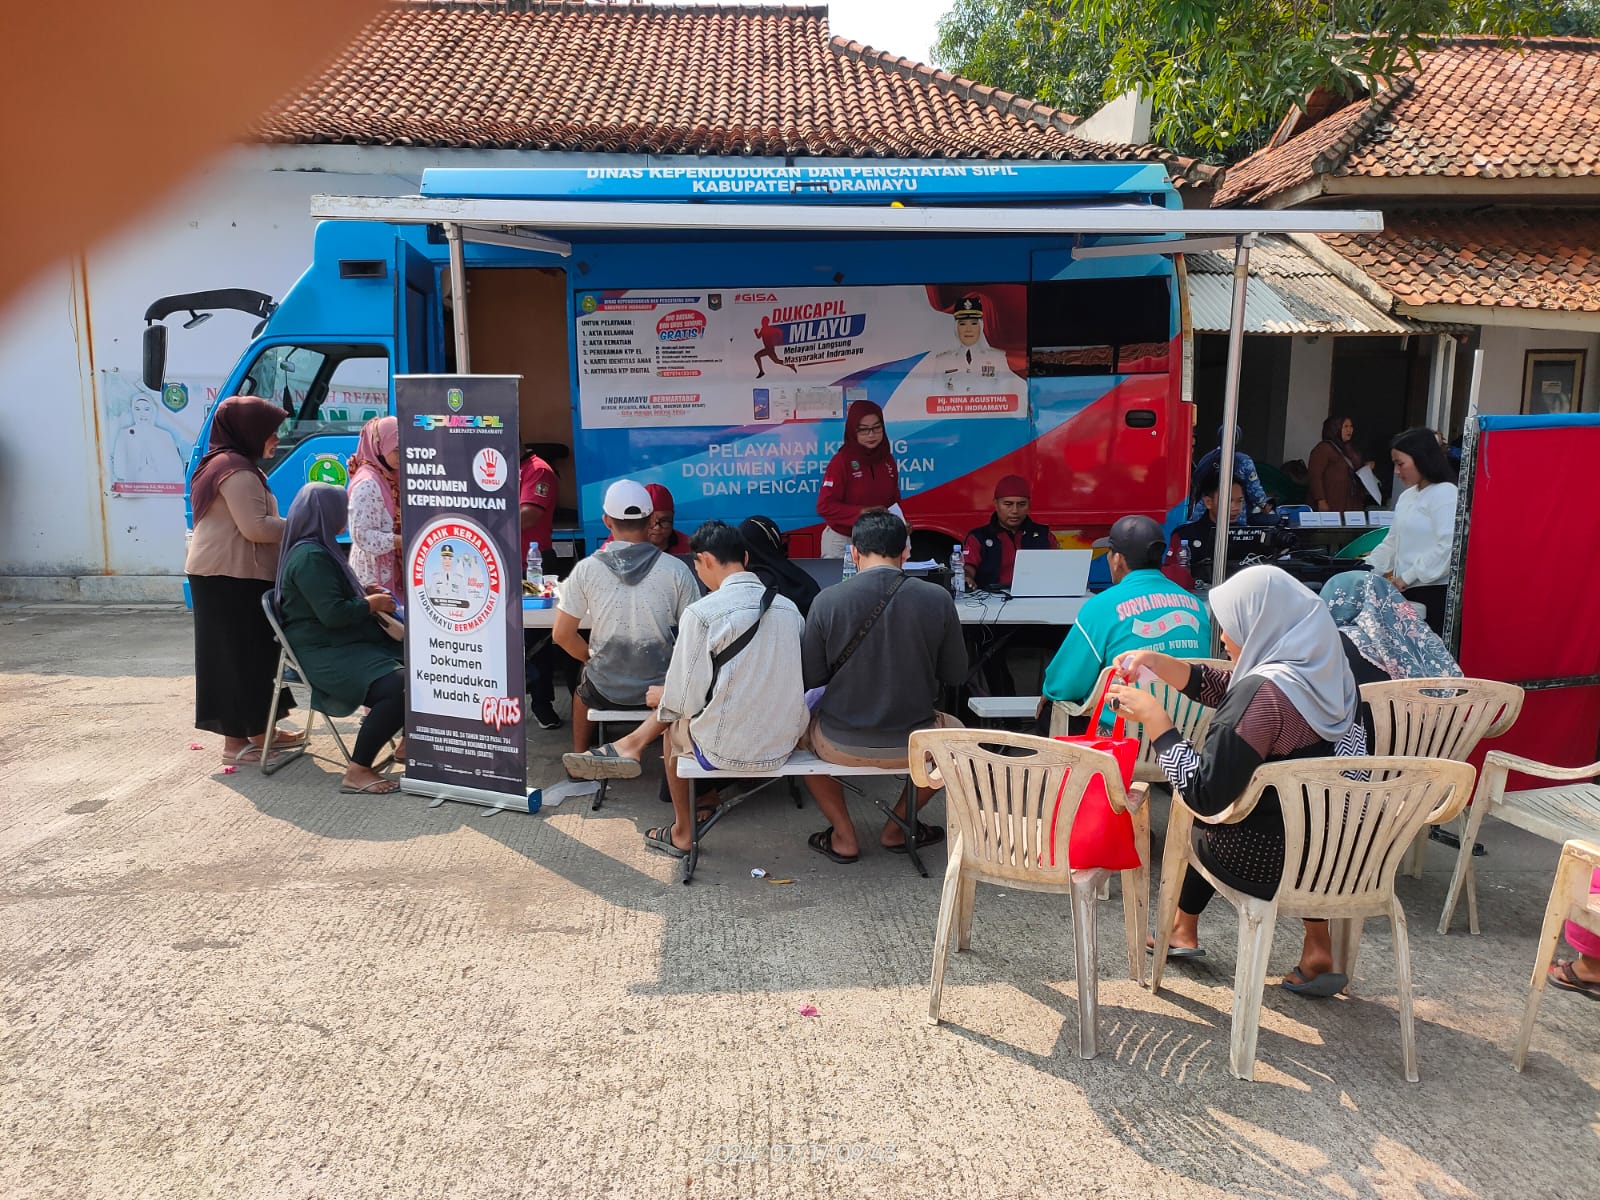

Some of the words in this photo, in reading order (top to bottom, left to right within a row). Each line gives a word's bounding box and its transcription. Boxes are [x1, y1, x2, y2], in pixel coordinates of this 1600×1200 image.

[587, 168, 643, 179] DINAS
[650, 168, 800, 179] KEPENDUDUKAN
[808, 167, 845, 178] DAN
[851, 166, 967, 177] PENCATATAN
[972, 166, 1018, 176] SIPIL
[735, 293, 778, 302] #GISA
[772, 300, 847, 323] DUKCAPIL
[659, 328, 698, 341] GRATIS
[789, 317, 851, 343] MLAYU
[784, 344, 816, 355] Melayani
[818, 340, 852, 350] Langsung
[784, 351, 825, 364] Masyarakat
[827, 347, 864, 358] Indramayu
[605, 396, 648, 404] INDRAMAYU
[950, 396, 968, 404] NINA
[969, 395, 1008, 403] AGUSTINA
[964, 404, 1009, 412] INDRAMAYU
[406, 447, 437, 459] STOP
[709, 440, 818, 458] PELAYANAN
[406, 463, 446, 476] MAFIA
[682, 461, 776, 478] DOKUMEN
[407, 479, 468, 492] DOKUMEN
[702, 480, 741, 496] DAN
[407, 494, 507, 511] KEPENDUDUKAN
[414, 548, 429, 580] KERJA
[428, 527, 449, 546] BAIK
[453, 527, 482, 548] KERJA
[482, 546, 498, 586] NYATA
[418, 590, 453, 630] INDRAMAYU
[454, 595, 497, 632] BERMARTABAT
[1116, 595, 1151, 621] SURYA
[429, 638, 483, 654] Mengurus
[430, 655, 482, 670] Dokumen
[416, 669, 498, 689] Kependudukan
[433, 688, 470, 703] Mudah
[472, 693, 481, 704] &
